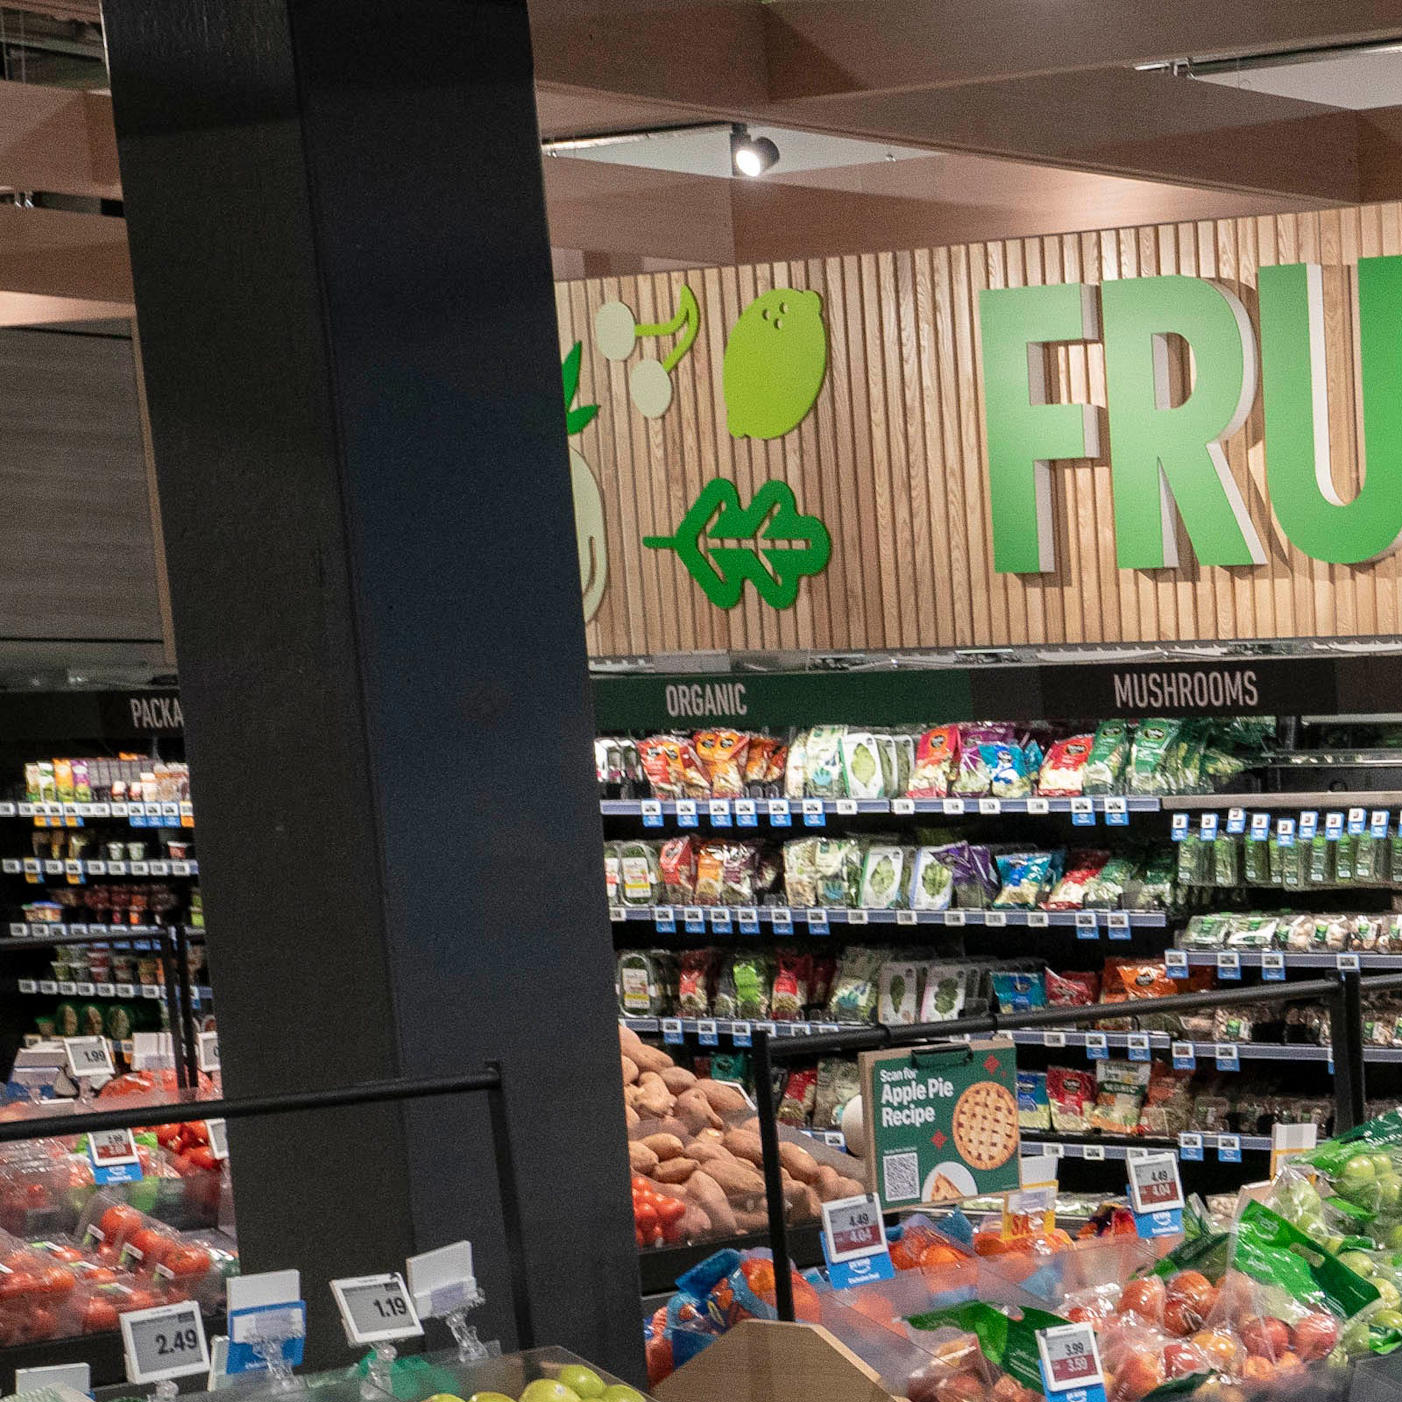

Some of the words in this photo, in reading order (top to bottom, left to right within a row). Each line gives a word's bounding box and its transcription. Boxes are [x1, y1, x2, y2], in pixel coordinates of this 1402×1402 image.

[665, 683, 748, 717] ORGANIC
[1113, 671, 1259, 708] MUSHROOMS
[880, 1067, 902, 1083] Scan
[902, 1066, 917, 1080] for
[881, 1081, 927, 1105] Apple
[928, 1078, 955, 1099] Pie
[881, 1103, 936, 1128] Recipe
[848, 1213, 870, 1227] 4.49
[849, 1229, 872, 1243] 4.04
[373, 1296, 408, 1318] 1.19
[155, 1327, 199, 1356] 2.49
[1063, 1341, 1085, 1356] 3.99
